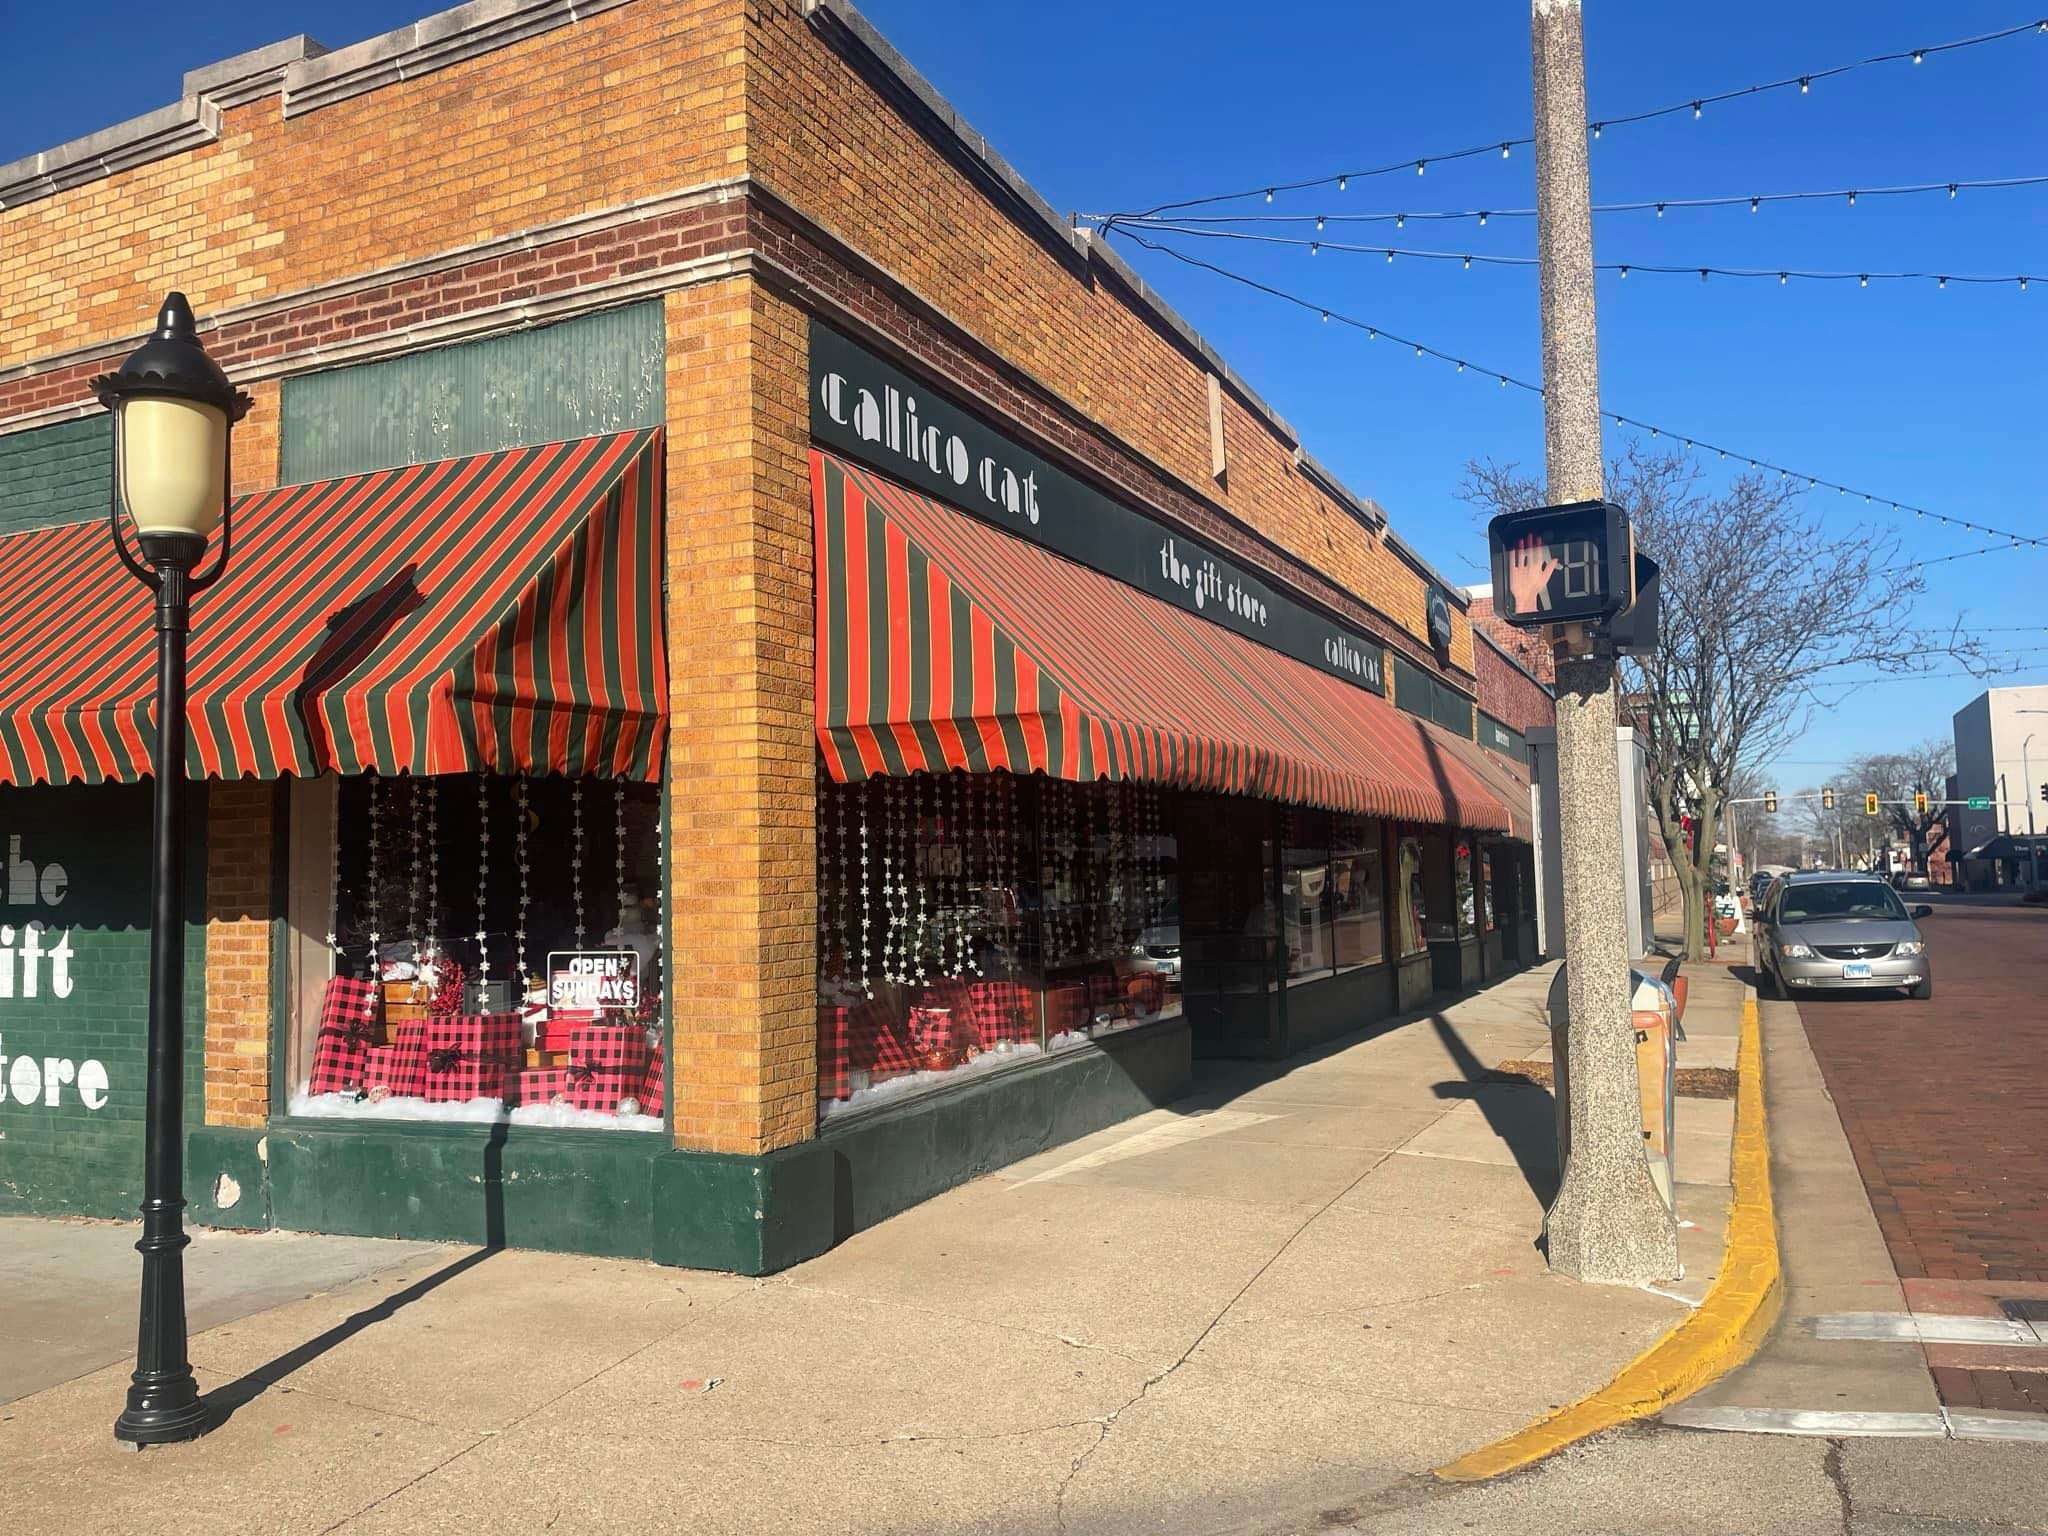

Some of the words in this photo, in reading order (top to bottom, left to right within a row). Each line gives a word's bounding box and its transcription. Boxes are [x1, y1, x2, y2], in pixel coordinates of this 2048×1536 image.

[821, 372, 969, 485] calico
[979, 456, 1040, 525] cat
[1160, 537, 1191, 590] the
[1195, 559, 1223, 609] gift
[1227, 574, 1267, 627] store
[1324, 635, 1361, 676] calico
[1362, 655, 1379, 687] cat
[0, 833, 69, 906] he
[551, 979, 635, 1000] SUNDAYS
[568, 957, 618, 977] OPEN
